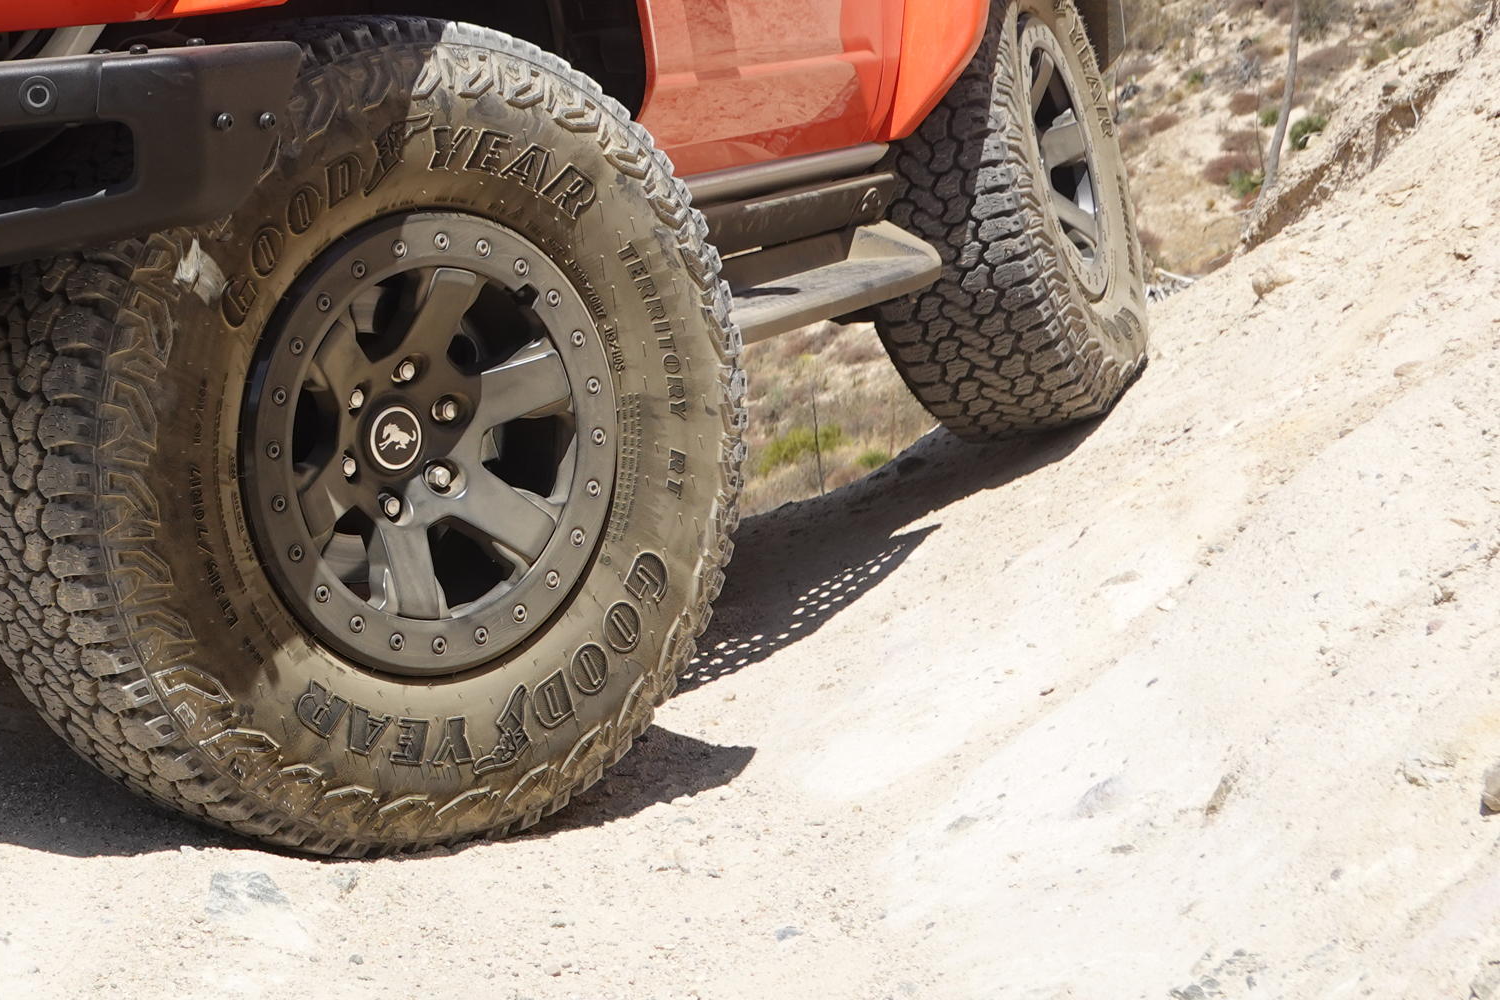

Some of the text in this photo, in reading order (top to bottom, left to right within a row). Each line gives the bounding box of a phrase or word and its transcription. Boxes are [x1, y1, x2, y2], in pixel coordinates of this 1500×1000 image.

[616, 240, 687, 420] TERRITORY
[664, 449, 688, 500] RT
[192, 463, 241, 629] LT315/70R17
